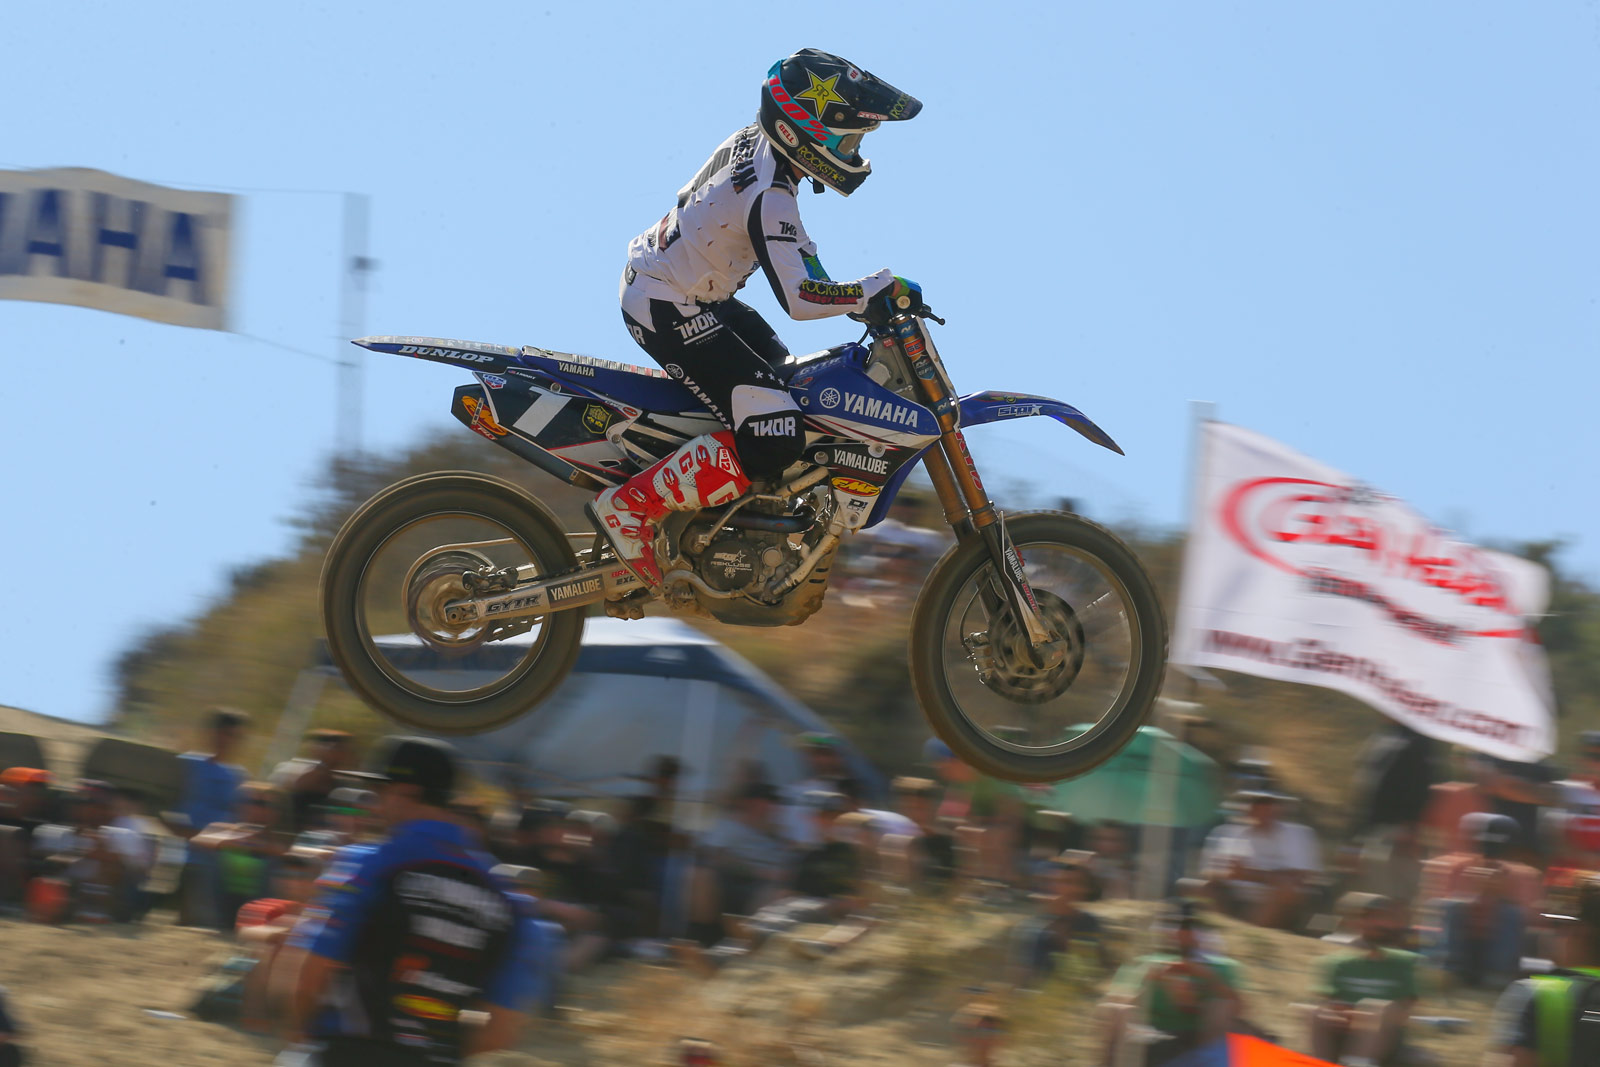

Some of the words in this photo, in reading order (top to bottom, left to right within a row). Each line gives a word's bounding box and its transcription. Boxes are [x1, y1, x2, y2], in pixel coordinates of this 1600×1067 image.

[779, 124, 794, 143] BELL
[674, 311, 719, 339] THOR
[399, 345, 494, 363] DUNLOP
[559, 362, 594, 377] YAMAHA
[844, 392, 919, 428] YAMAHA
[749, 417, 796, 437] THOR
[833, 449, 889, 475] YAMALUBE
[832, 479, 880, 493] FMF
[1005, 547, 1023, 582] YAMALUBE
[551, 579, 601, 600] YAMALUBE
